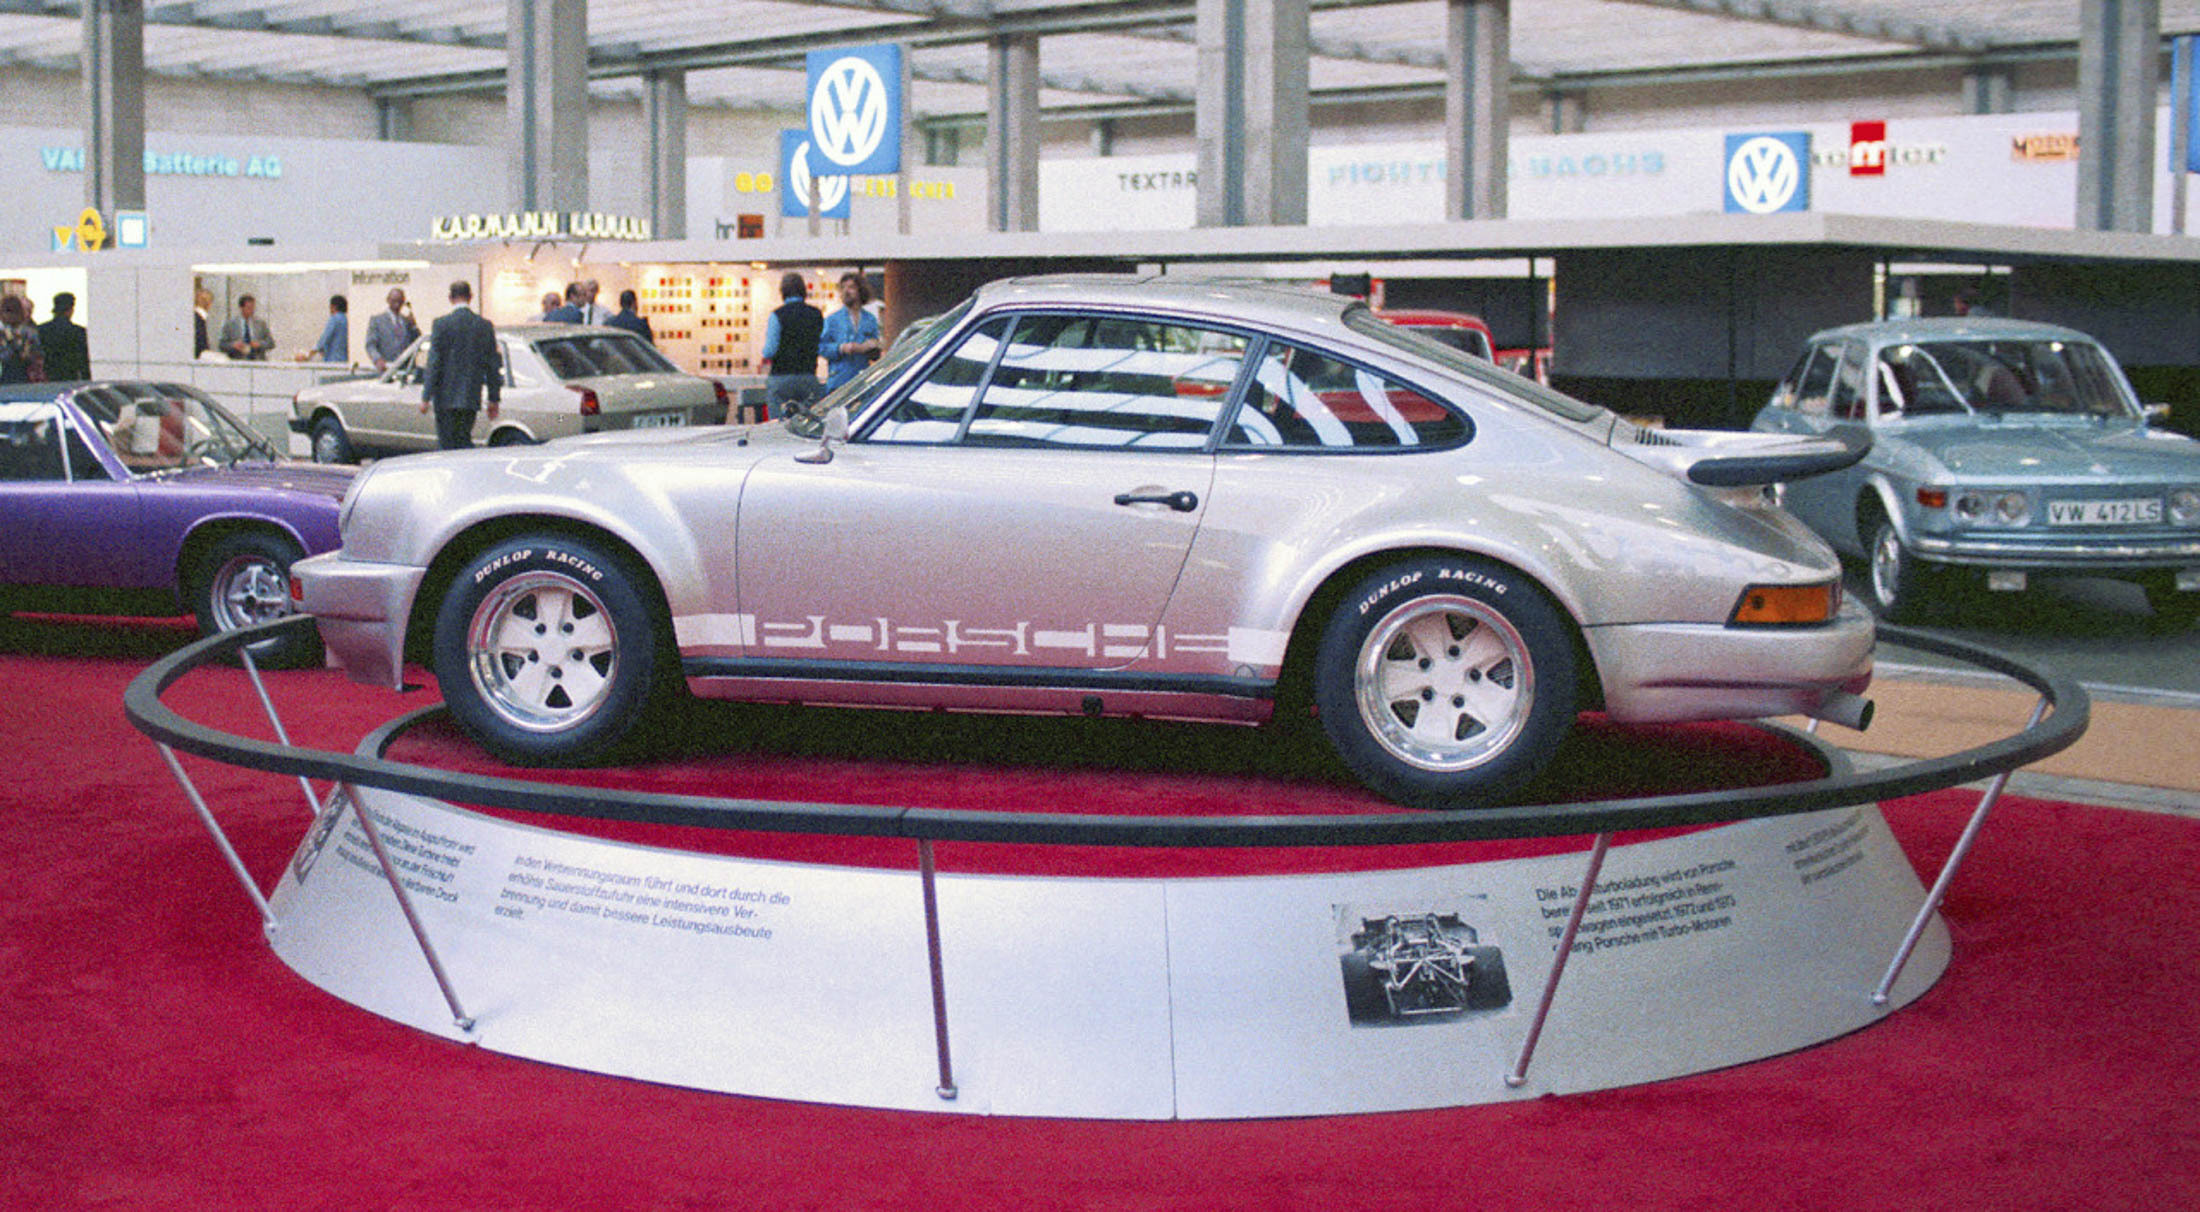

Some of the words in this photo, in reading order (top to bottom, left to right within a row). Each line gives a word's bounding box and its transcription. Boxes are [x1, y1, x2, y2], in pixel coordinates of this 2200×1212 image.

[246, 154, 283, 179] AG
[431, 211, 559, 240] KARMANN
[570, 210, 650, 240] KARMANN
[352, 265, 411, 286] Information
[2050, 502, 2086, 522] VW
[474, 549, 533, 584] DUNLOP
[545, 549, 604, 581] RACING
[1358, 571, 1423, 615] DUNLOP
[1438, 568, 1508, 595] RACING
[754, 614, 1229, 662] PORSCHE
[543, 858, 642, 888] Verbrennungsraum
[644, 876, 673, 892] führt
[675, 882, 700, 896] und
[700, 883, 728, 899] dort
[729, 887, 767, 904] durch
[768, 892, 792, 906] die
[545, 878, 636, 905] Sauerstoffzufuhr
[635, 893, 662, 907] eine
[663, 896, 731, 916] intensivere
[733, 905, 759, 919] Ver-
[1535, 888, 1559, 902] Die
[1698, 859, 1736, 876] Porsche
[500, 887, 547, 910] brennung
[547, 898, 570, 911] und
[569, 900, 602, 916] damit
[602, 905, 650, 925] bessere
[651, 913, 774, 940] Leistungsausbeute
[1594, 931, 1641, 949] Porsche
